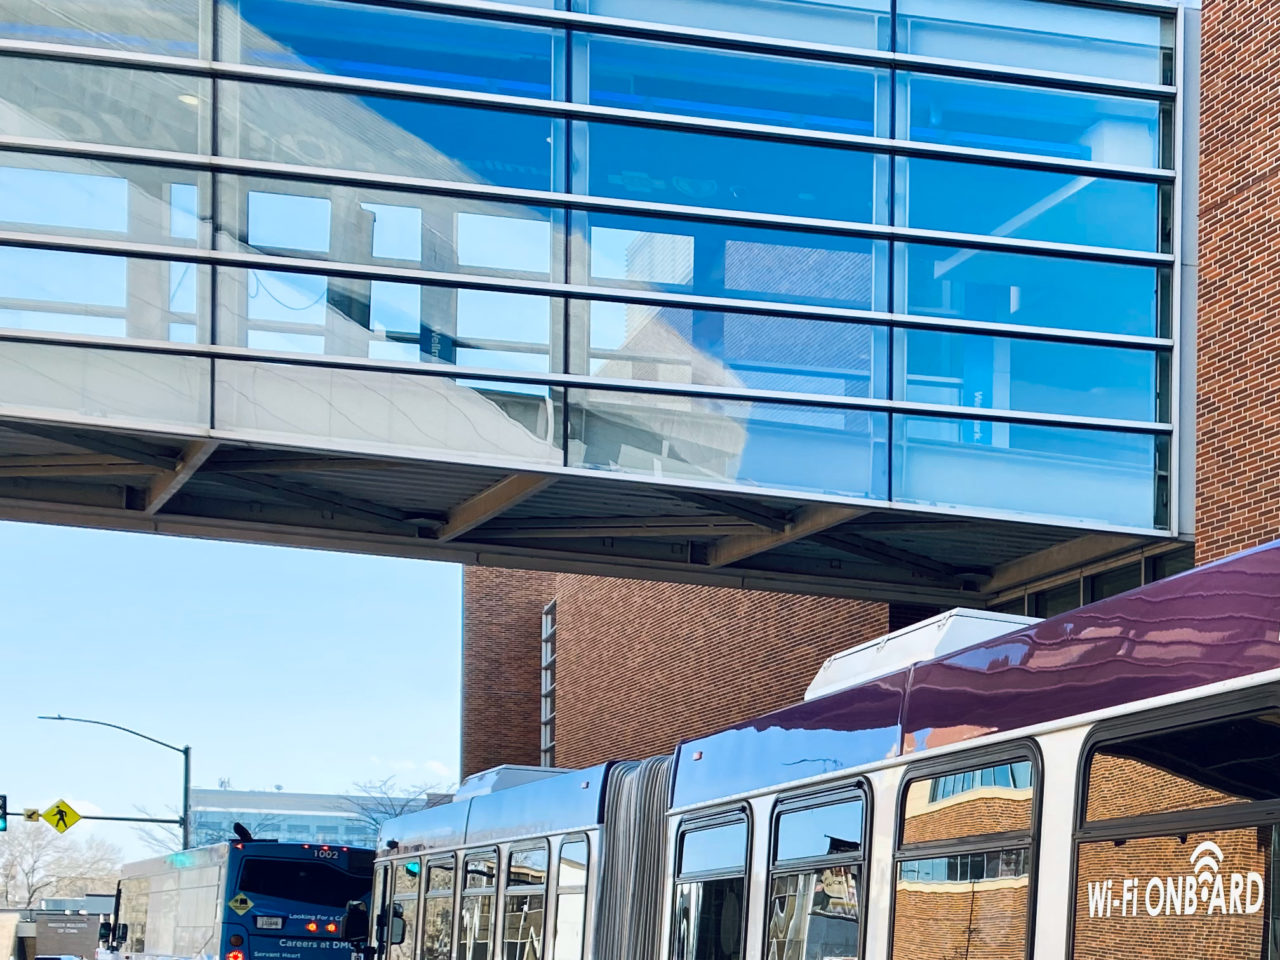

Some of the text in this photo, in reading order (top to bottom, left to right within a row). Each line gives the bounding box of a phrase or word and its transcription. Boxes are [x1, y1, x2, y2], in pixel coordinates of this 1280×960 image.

[313, 850, 339, 859] 1002
[1088, 877, 1139, 918] Wi-Fi
[288, 913, 315, 921] Looking
[279, 939, 318, 948] Careers
[320, 940, 330, 948] at
